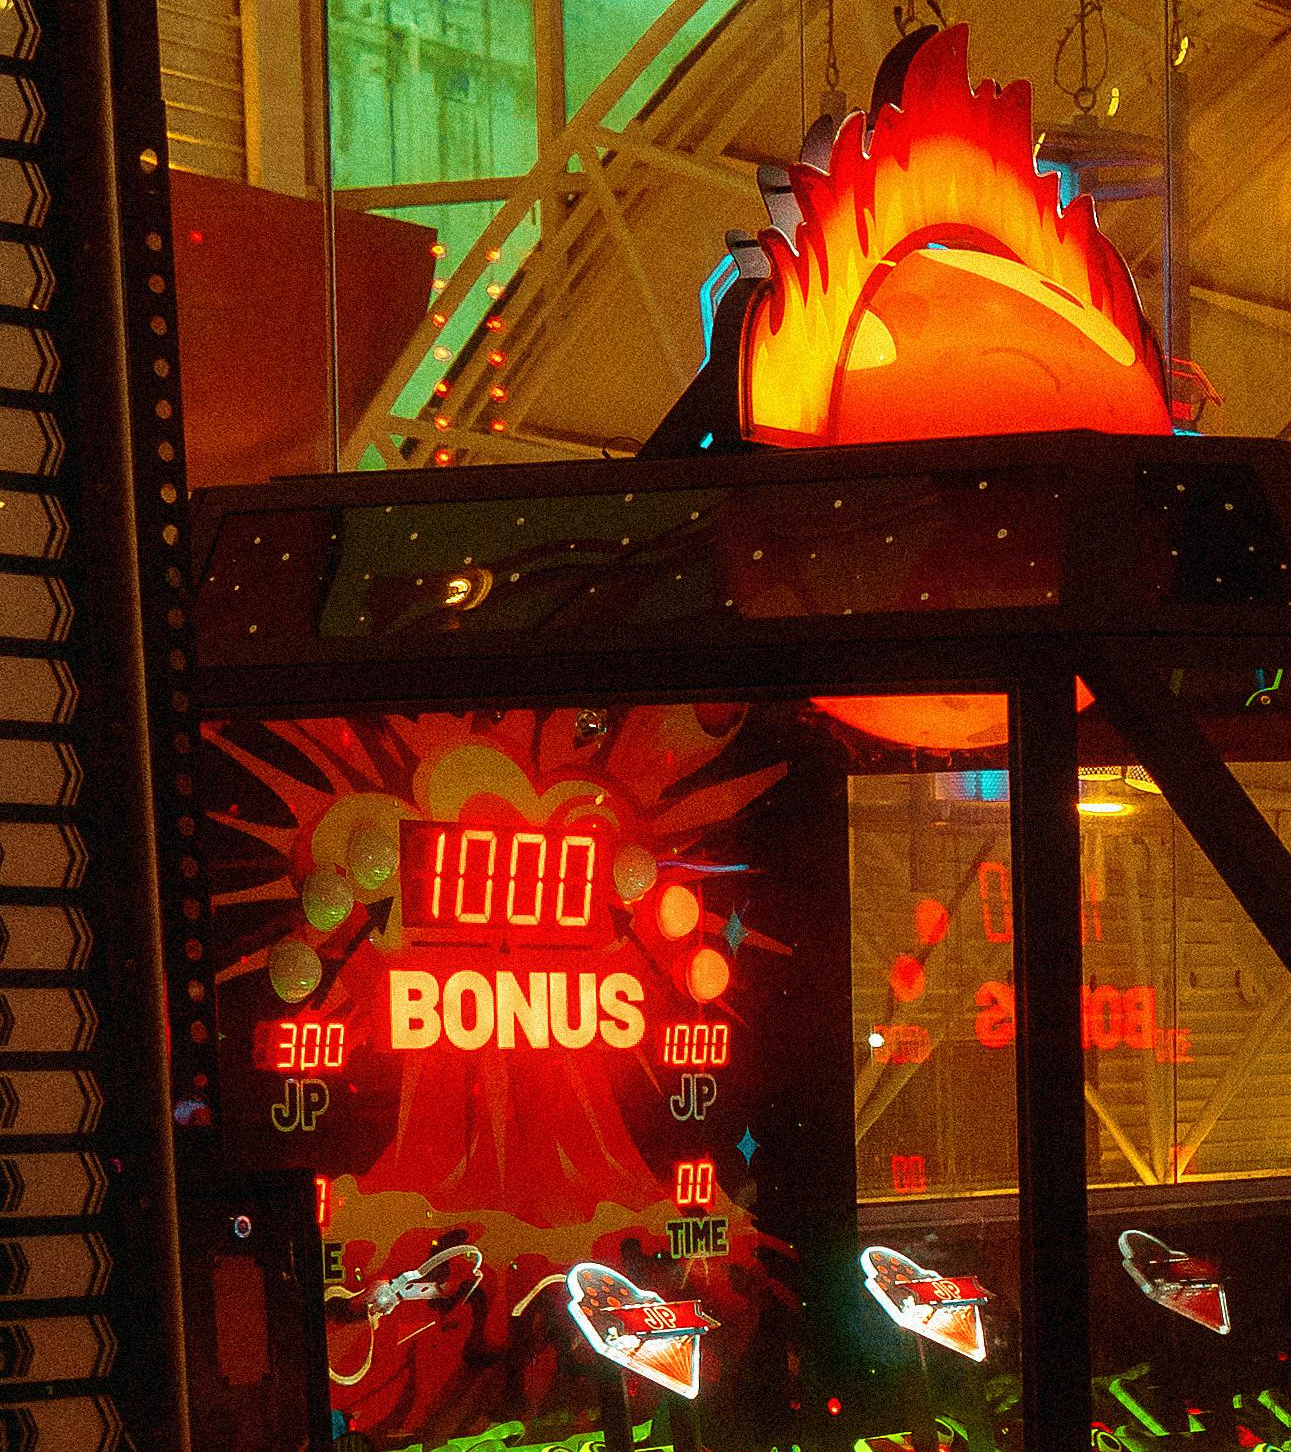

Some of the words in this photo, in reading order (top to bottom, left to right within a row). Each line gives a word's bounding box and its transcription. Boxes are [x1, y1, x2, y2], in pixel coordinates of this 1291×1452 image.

[430, 829, 596, 926] 1000
[389, 970, 646, 1050] BONUS
[276, 1022, 344, 1069] 300
[664, 1024, 729, 1065] 1000
[271, 1078, 330, 1132] JP
[670, 1073, 717, 1122] JP
[676, 1163, 713, 1204] 00
[666, 1216, 729, 1259] TIME
[643, 1305, 677, 1330] JP
